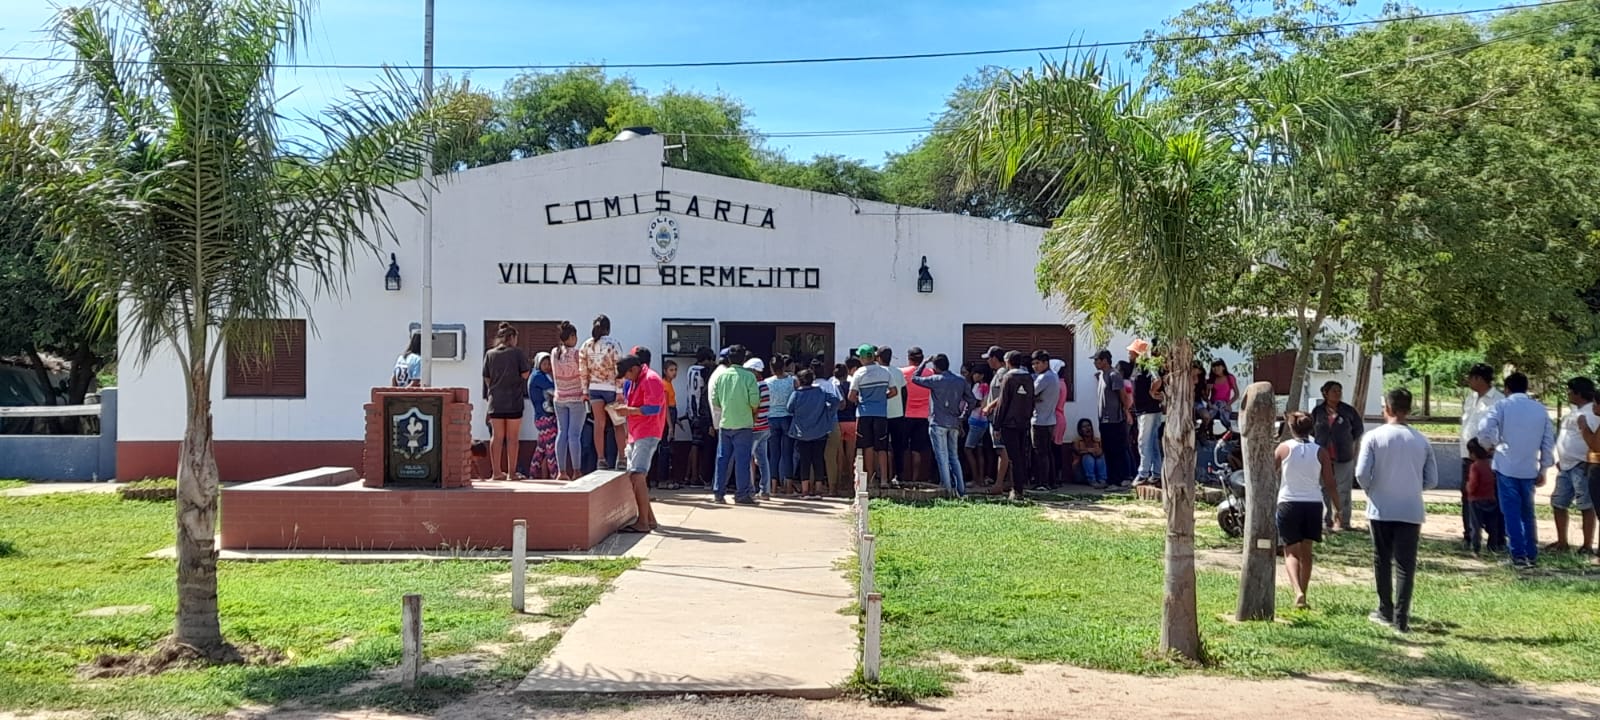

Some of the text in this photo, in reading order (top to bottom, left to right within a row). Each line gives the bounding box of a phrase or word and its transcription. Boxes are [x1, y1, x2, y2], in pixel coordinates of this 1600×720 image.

[545, 190, 775, 230] COMISARIA
[648, 217, 679, 239] POLICIA
[498, 263, 820, 289] VILLA RIO BERMEJITO
